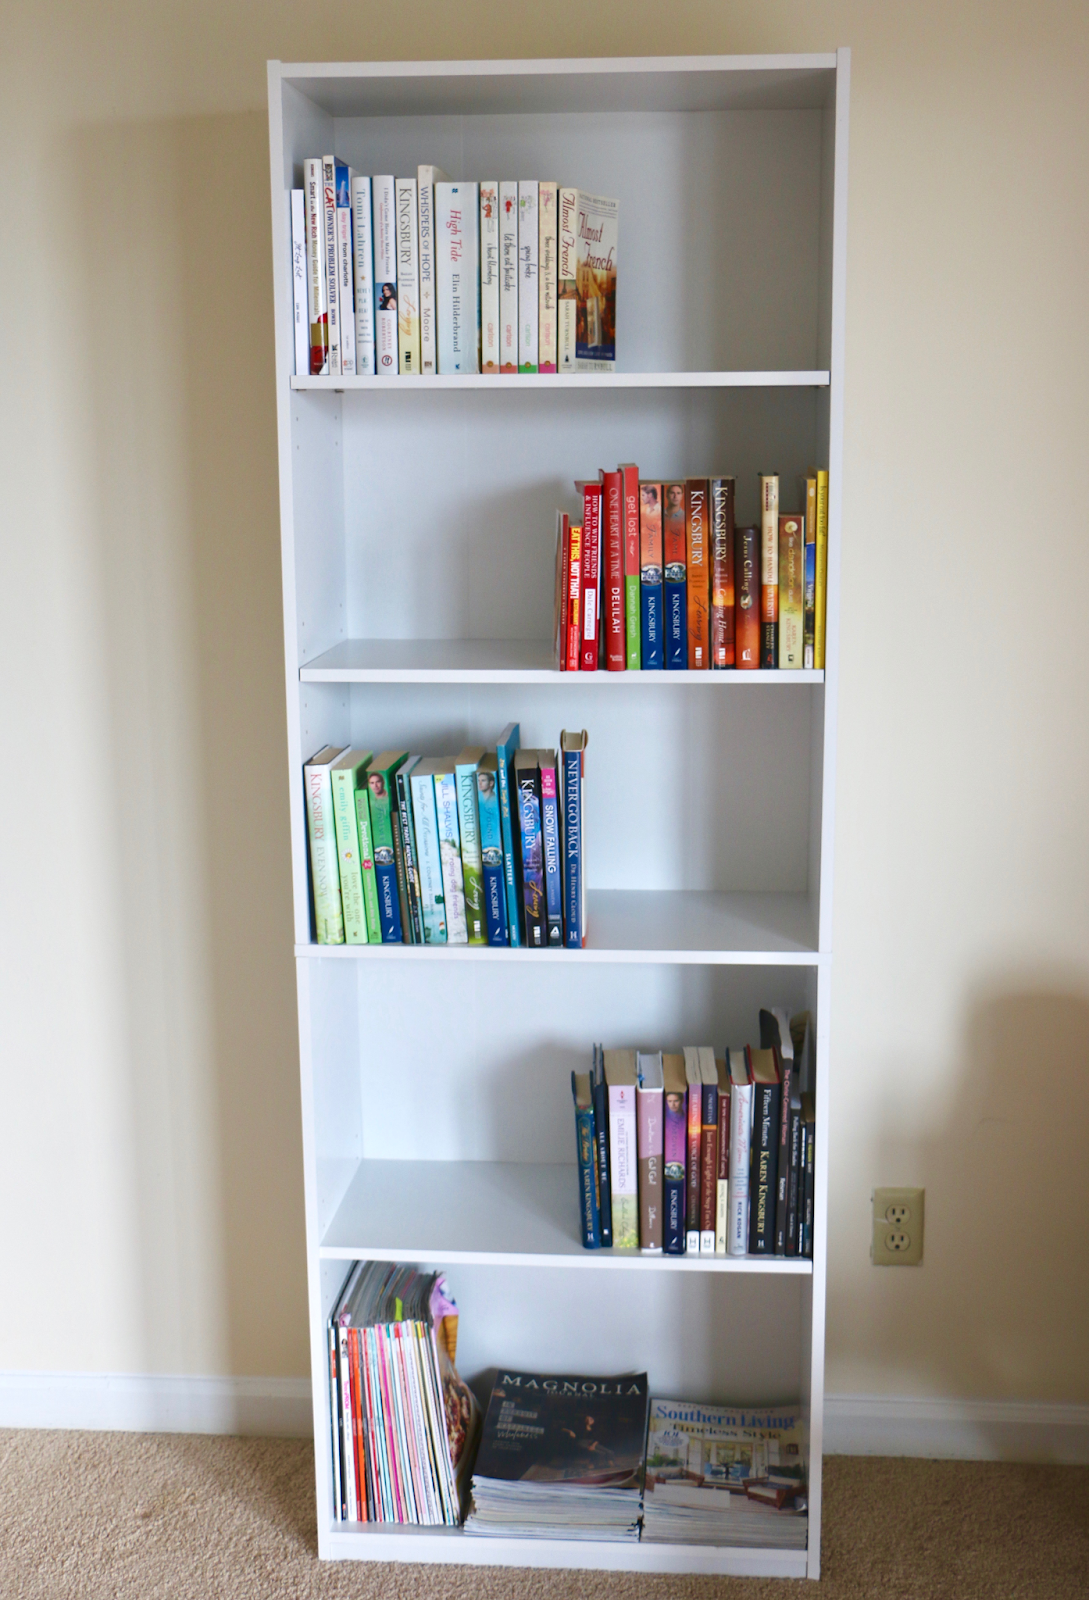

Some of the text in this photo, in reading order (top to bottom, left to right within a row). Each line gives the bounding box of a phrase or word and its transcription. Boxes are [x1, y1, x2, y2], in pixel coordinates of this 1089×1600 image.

[324, 187, 336, 212] CAT
[420, 186, 430, 238] WHISPERS
[327, 210, 335, 242] OWNER'S
[356, 188, 367, 268] Tomi Lahren
[400, 188, 412, 266] KINGSBURY
[446, 209, 462, 262] High Tide
[562, 192, 576, 279] Almost French
[578, 211, 604, 244] Almost
[328, 244, 336, 276] PROBLEM
[422, 254, 431, 283] HOPE
[583, 242, 615, 272] French
[424, 308, 432, 342] Moore
[452, 274, 462, 353] Elin Hilderbrand
[592, 516, 598, 526] TO
[610, 488, 620, 580] ONE HEART AT A TIME
[626, 495, 638, 536] get lost
[690, 490, 704, 567] KINGSBURY
[714, 486, 728, 563] KINGSBURY
[570, 528, 580, 599] EAT THIS, NOT THAT!
[741, 535, 754, 591] Jesus Calling
[766, 546, 774, 556] TO
[788, 548, 796, 588] dandelion
[585, 607, 594, 639] Carnegie
[612, 587, 620, 634] DELILAH
[648, 596, 656, 642] KINGSBURY
[672, 594, 680, 640] KINGSBURY
[714, 588, 726, 618] Coming
[718, 620, 727, 644] Home
[310, 773, 325, 842] KINGSBURY
[338, 786, 350, 841] emily giffin
[440, 780, 454, 838] JILL SHALVIS
[461, 774, 476, 846] KINGSBURY
[521, 778, 536, 851] KINGSBURY
[545, 804, 556, 834] SNOW
[568, 760, 578, 858] NEVER GO BACK
[316, 846, 326, 871] EVEN
[360, 820, 370, 860] Devotional
[546, 836, 556, 874] FALLING
[342, 874, 354, 922] you're with
[351, 872, 360, 889] love
[352, 892, 360, 906] the
[382, 875, 393, 919] KINGSBURY
[448, 858, 460, 920] rainy dog friends
[490, 876, 500, 920] KINGSBURY
[782, 1080, 790, 1124] Christ-Centered
[617, 1118, 626, 1189] EMILIE RICHARDS
[648, 1156, 656, 1170] God
[691, 1162, 698, 1172] OF
[704, 1165, 712, 1180] Light
[705, 1142, 713, 1165] Enough
[758, 1088, 772, 1234] Fifteen Minutes KAREN KINGSBURY
[583, 1168, 594, 1231] KAREN KINGSBURY
[670, 1189, 678, 1230] KINGSBURY
[502, 1374, 642, 1396] MAGNOLIA
[656, 1405, 736, 1426] Southern
[740, 1414, 796, 1431] Living
[669, 1422, 782, 1440] Timeless Style
